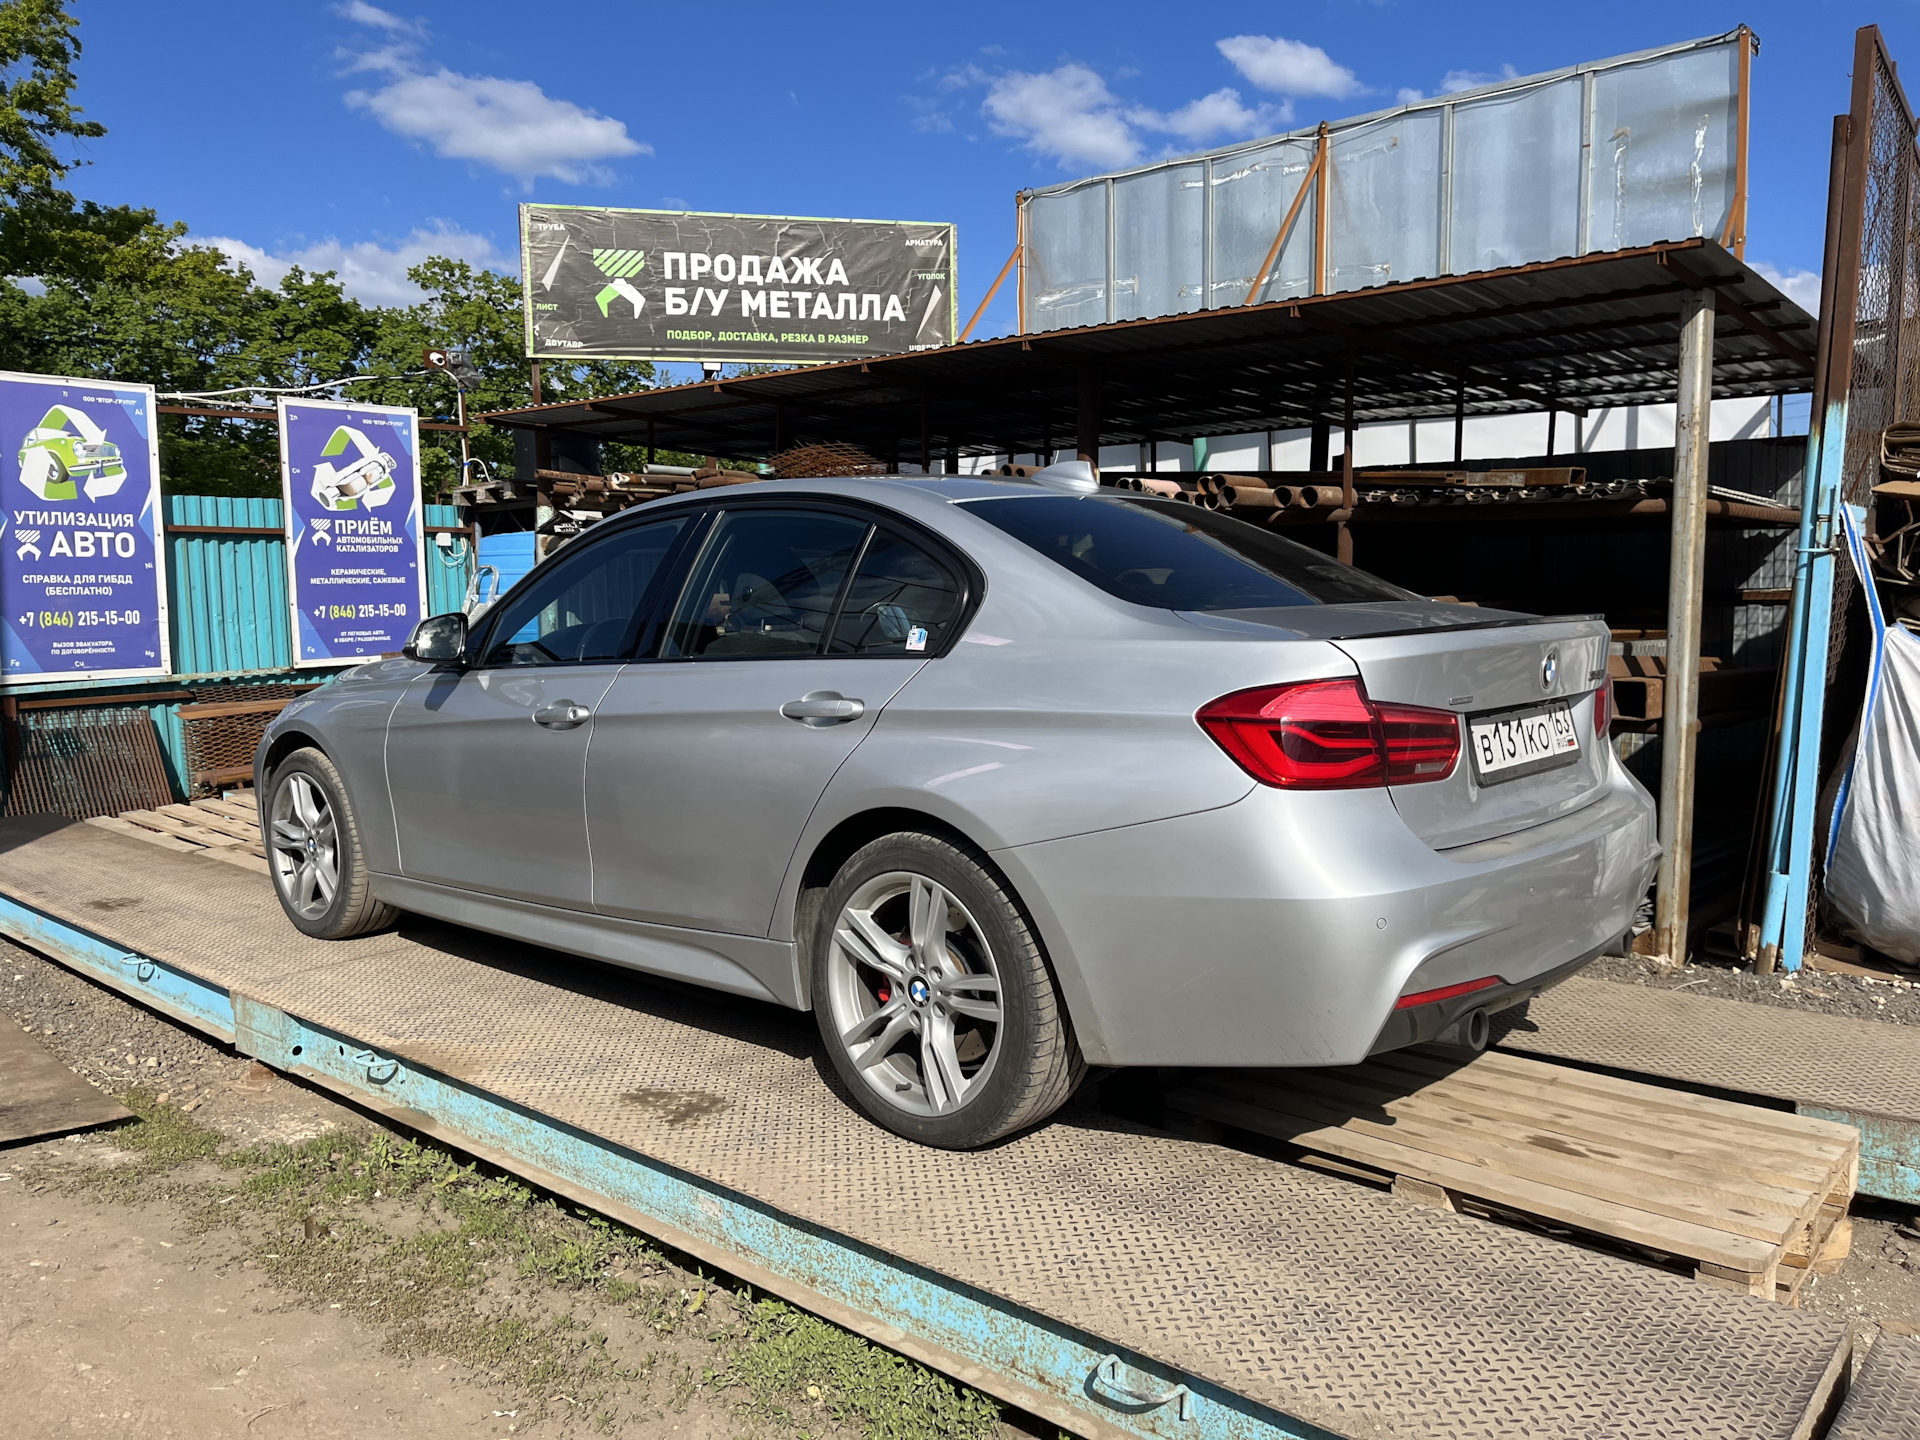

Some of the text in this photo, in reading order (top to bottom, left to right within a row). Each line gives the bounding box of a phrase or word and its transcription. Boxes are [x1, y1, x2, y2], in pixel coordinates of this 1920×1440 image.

[537, 223, 566, 231] ТРУБА
[905, 239, 943, 247] АРМАТУРА
[663, 252, 850, 286] ПРОДАЖА
[917, 272, 946, 280] УГОЛОК
[536, 303, 559, 311] ЛИСТ
[664, 287, 906, 321] Б/У МЕТАЛЛА
[666, 330, 869, 344] ПОДБОР, ДОСТАВКА, РЕЗКА В РАЗМЕР
[545, 339, 584, 349] ДВУТАВР
[13, 510, 134, 530] УТИЛИЗАЦИЯ
[334, 517, 393, 535] ПРИЁМ
[49, 530, 136, 558] АВТО
[336, 536, 403, 545] АВТОМОБИЛЬНЫХ
[336, 544, 399, 553] КАТАЛИЗАТОРОВ
[331, 568, 386, 576] КЕРАМИЧЕСКИЕ,
[22, 574, 134, 585] СПРАВКА ДЛЯ ГИБДД
[310, 576, 406, 585] МЕТАЛЛИЧЕСКИЕ, САЖЕВЫЕ
[45, 586, 113, 597] (БЕСПЛАТНО)
[313, 603, 407, 620] +7 (846) 215-15-00
[19, 610, 141, 629] +7 (846) 215-15-00
[75, 640, 113, 648] ЭВАКУАТОРА
[10, 659, 20, 667] Fe
[1548, 706, 1570, 736] 163
[1556, 736, 1569, 748] RUS
